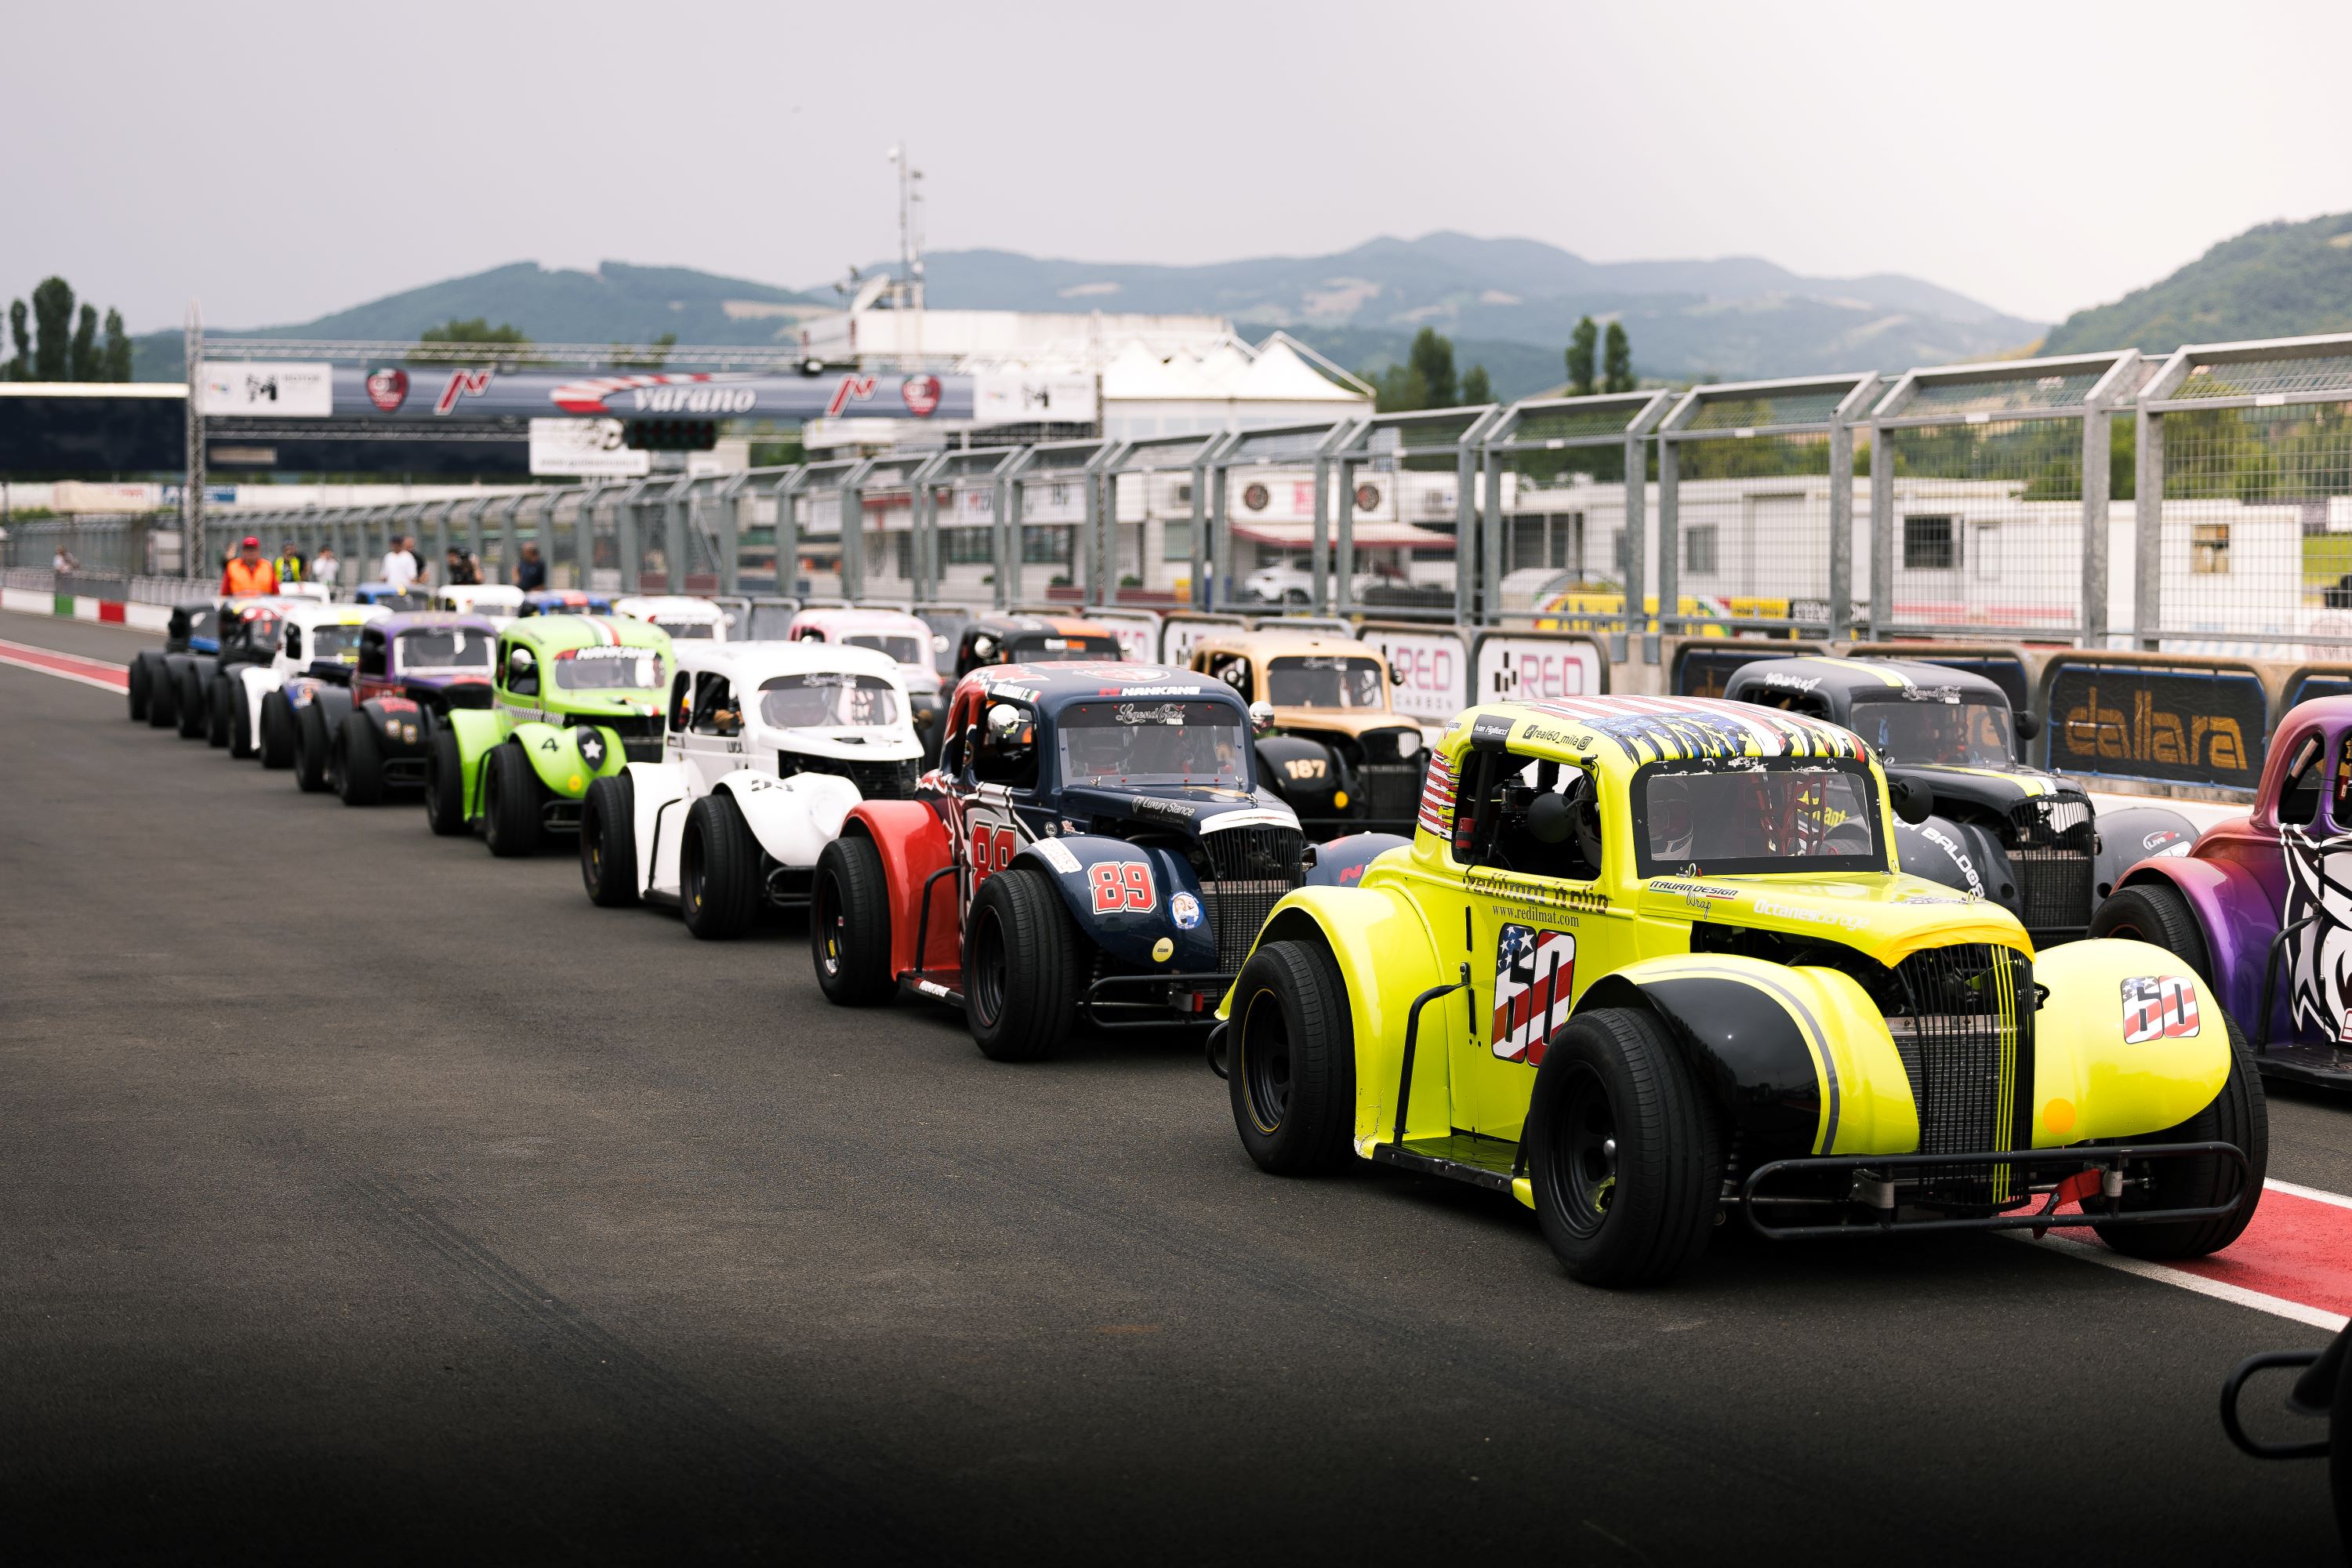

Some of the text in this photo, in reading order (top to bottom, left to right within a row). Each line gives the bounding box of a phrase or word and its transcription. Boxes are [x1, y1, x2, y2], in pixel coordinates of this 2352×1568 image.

[633, 387, 758, 414] varano
[1284, 758, 1327, 780] 187
[1142, 797, 1196, 817] Luxury Stance
[1087, 861, 1157, 915] 89
[1649, 880, 1738, 896] ITALIAN DESIGN
[1492, 905, 1580, 927] www.redilmat.com
[2120, 975, 2201, 1044] 60
